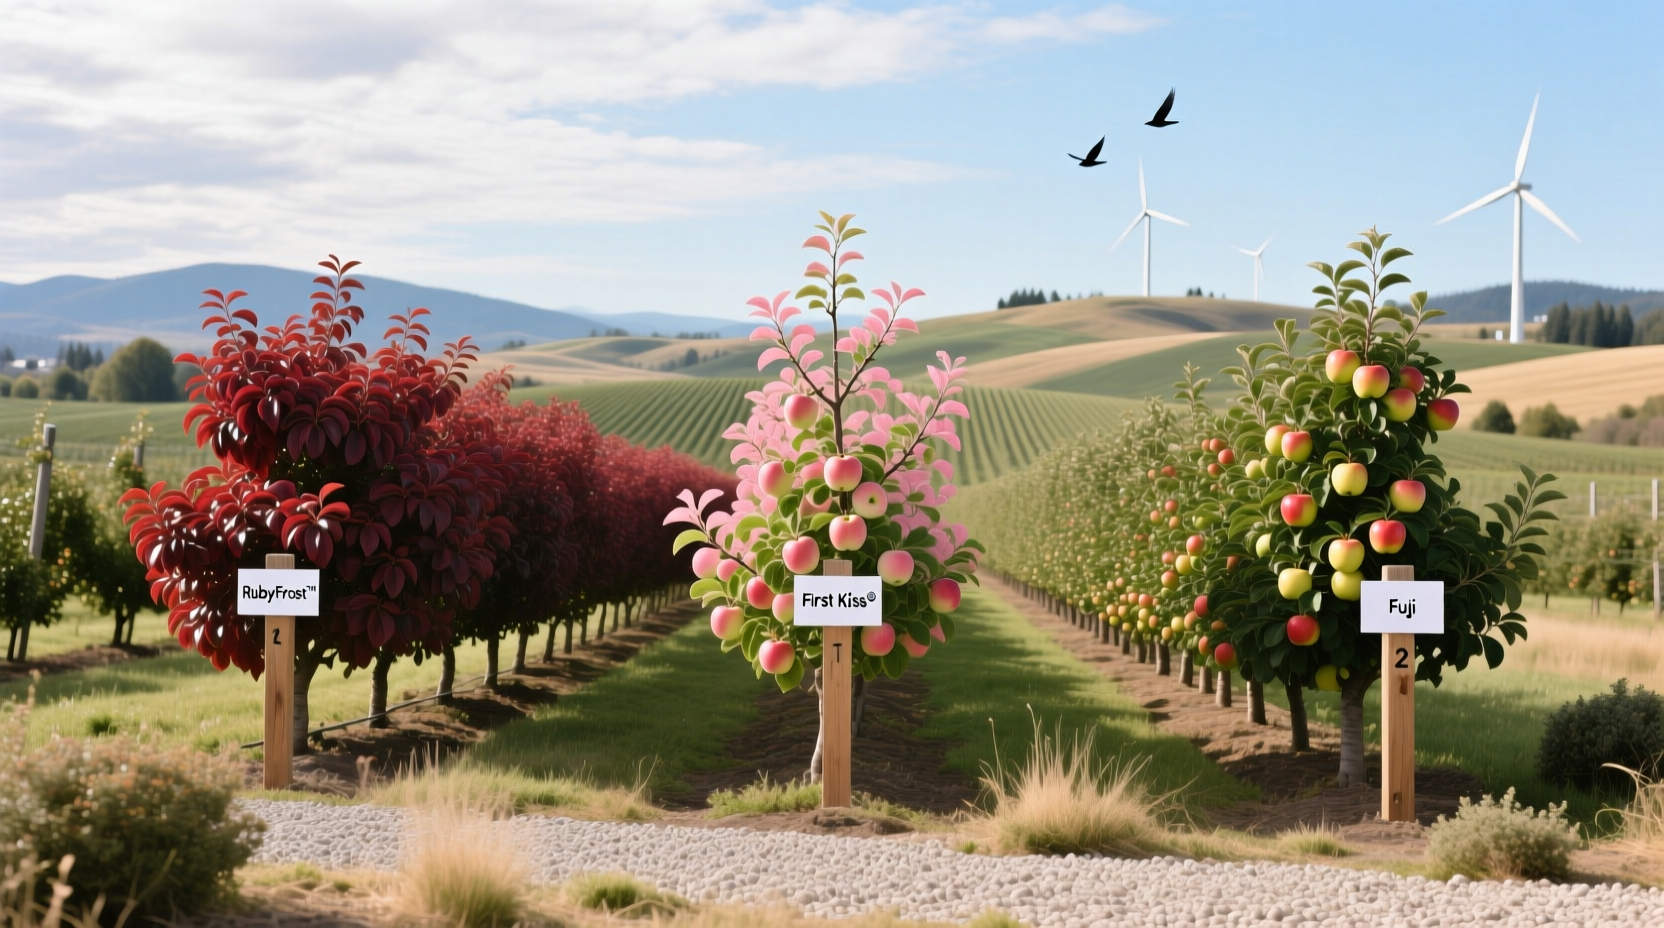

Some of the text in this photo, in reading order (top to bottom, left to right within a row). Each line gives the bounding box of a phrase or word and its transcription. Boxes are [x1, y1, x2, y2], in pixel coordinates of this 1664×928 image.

[802, 592, 834, 608] First
[1389, 598, 1416, 619] Fuji
[1394, 647, 1409, 669] 2
